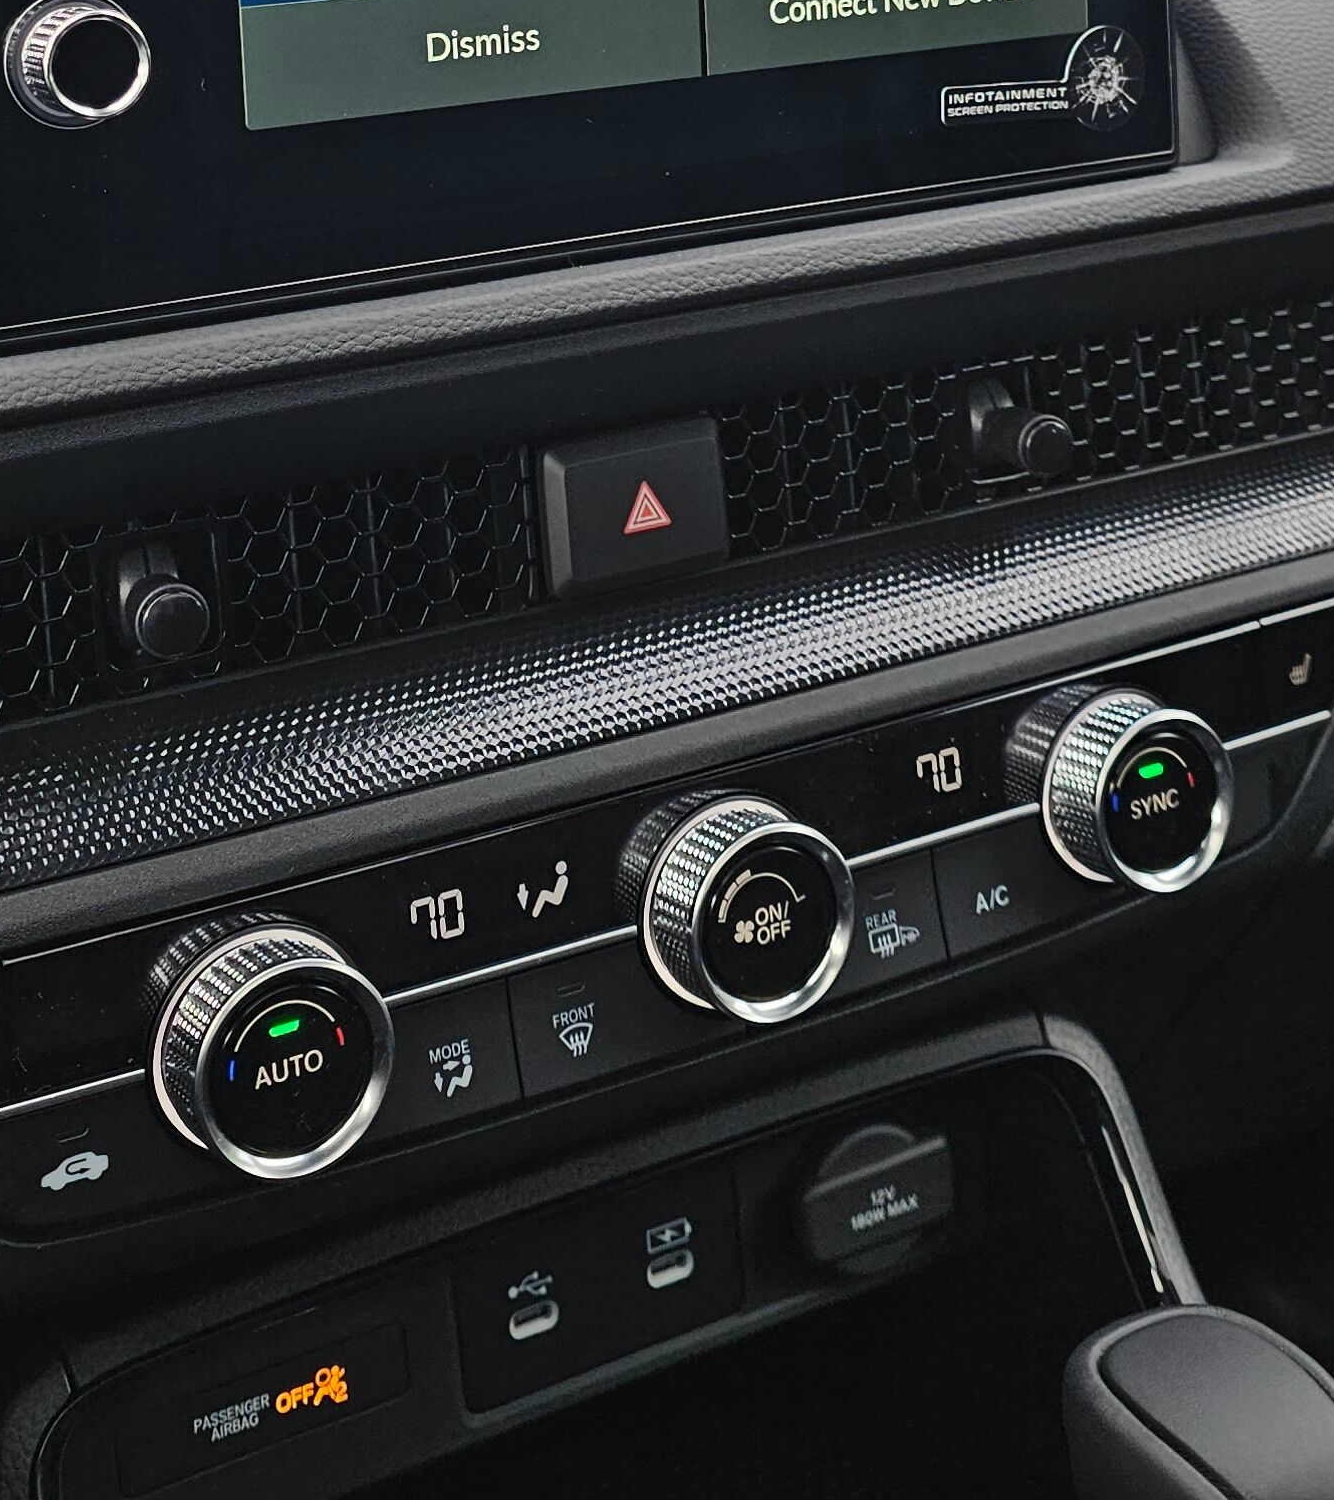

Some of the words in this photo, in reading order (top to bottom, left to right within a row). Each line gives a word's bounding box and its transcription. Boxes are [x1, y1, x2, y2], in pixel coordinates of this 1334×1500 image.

[427, 25, 540, 62] Dismiss
[947, 104, 993, 117] SCREEN
[995, 100, 1068, 112] PROTECTION
[949, 88, 1066, 104] INFOTAINMENT
[916, 747, 962, 792] 70
[1131, 789, 1179, 819] SYNC
[411, 889, 464, 939] 70
[755, 901, 790, 927] ON/
[976, 885, 1009, 914] A/C
[756, 919, 792, 947] OFF
[866, 909, 897, 931] REAR
[552, 1003, 596, 1029] FRONT
[429, 1039, 471, 1064] MODE
[255, 1050, 323, 1089] AUTO
[275, 1382, 315, 1414] OFF
[193, 1393, 270, 1434] PASSENGER
[211, 1412, 260, 1443] AIRBAG
